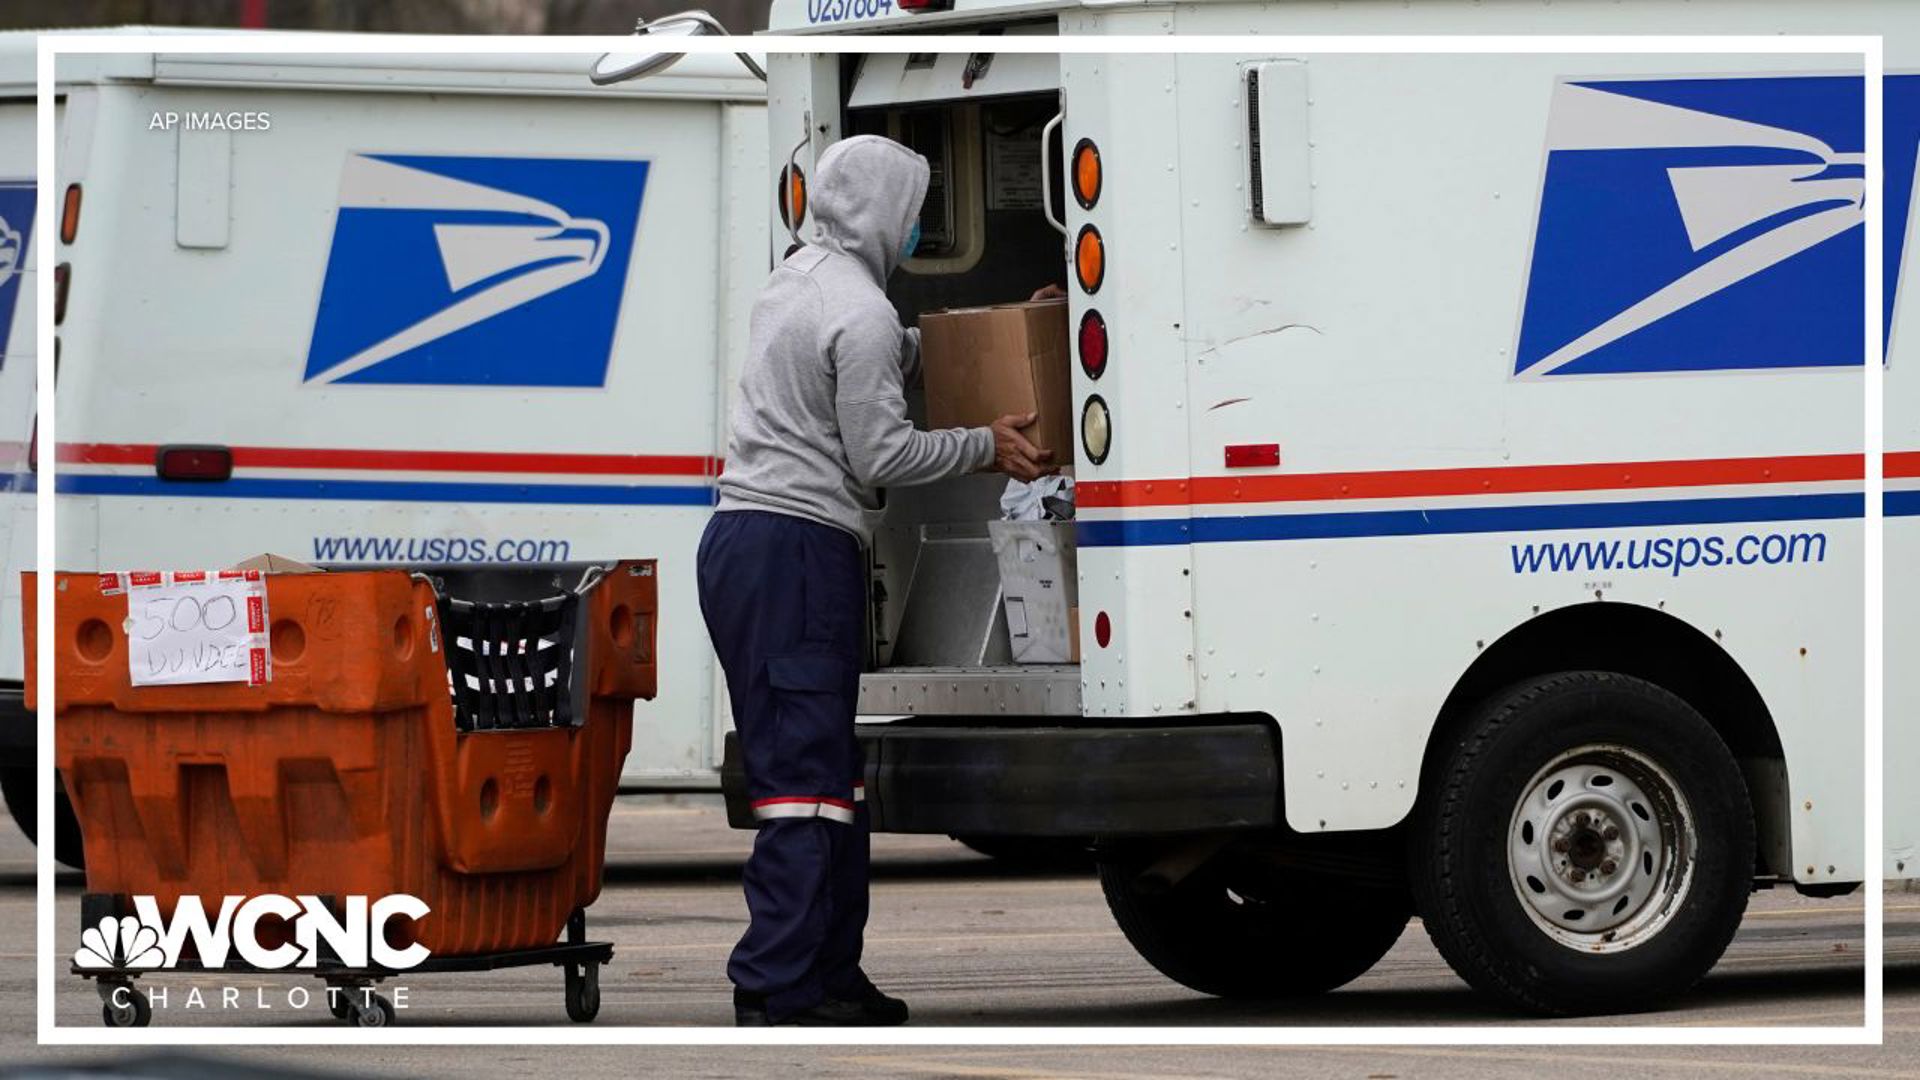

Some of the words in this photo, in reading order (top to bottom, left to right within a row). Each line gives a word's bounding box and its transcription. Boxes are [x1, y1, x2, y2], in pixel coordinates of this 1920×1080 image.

[313, 537, 571, 562] www.usps.com
[1511, 532, 1826, 577] www.usps.com
[142, 594, 237, 640] 500
